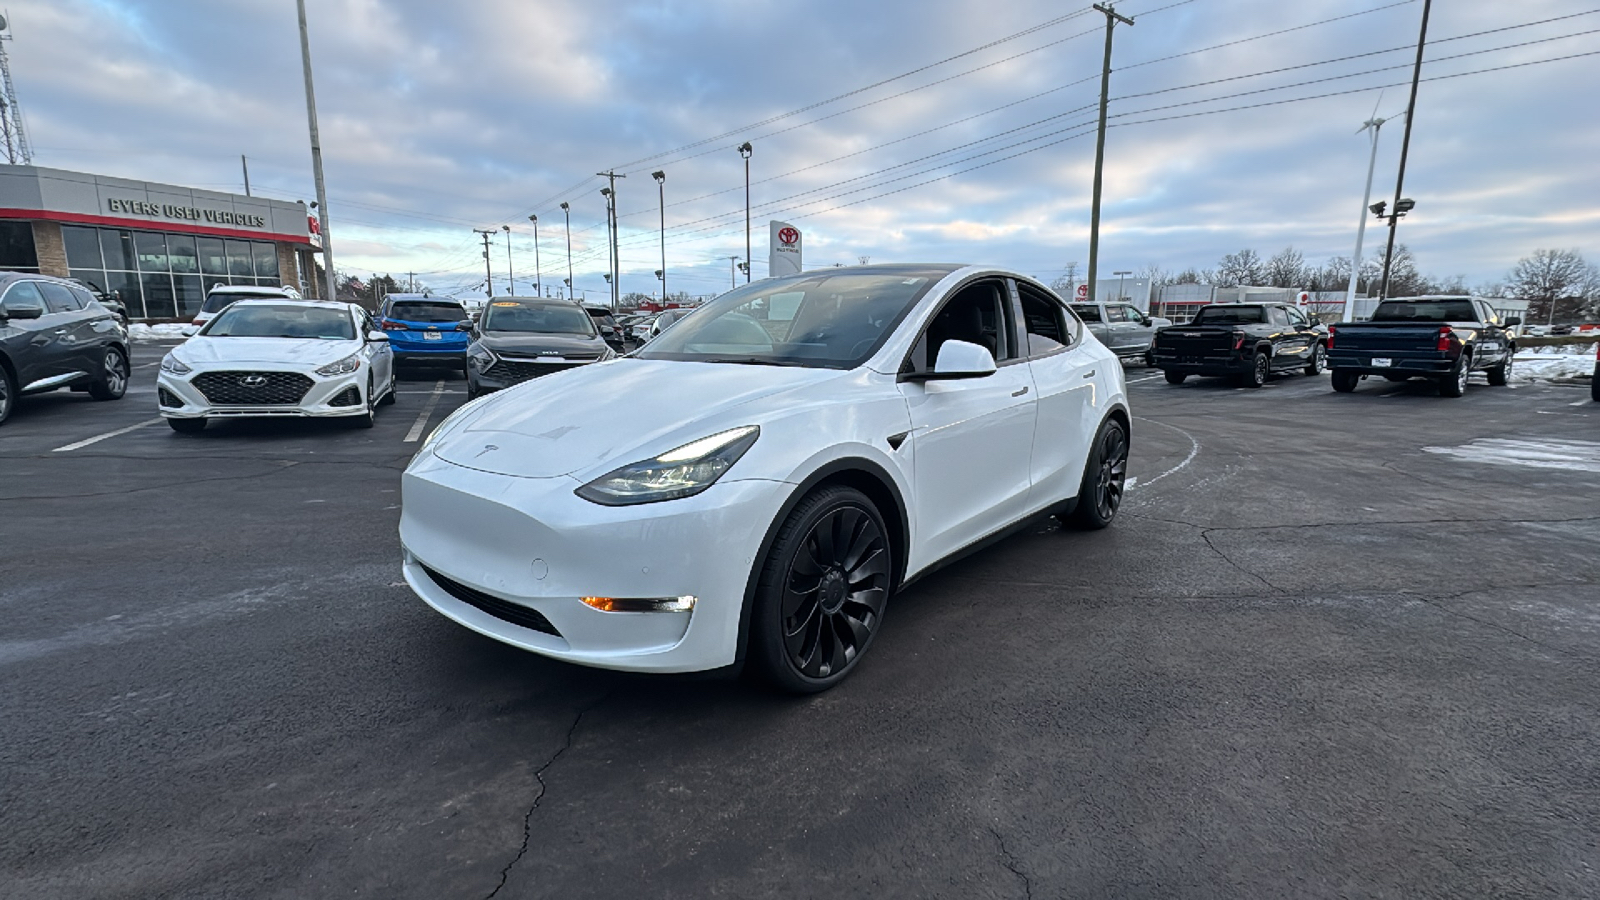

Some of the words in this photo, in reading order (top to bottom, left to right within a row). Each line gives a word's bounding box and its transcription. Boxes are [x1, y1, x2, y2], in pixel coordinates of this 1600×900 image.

[109, 198, 161, 216] BYERS
[163, 204, 202, 220] USED
[204, 209, 265, 228] VEHICLES
